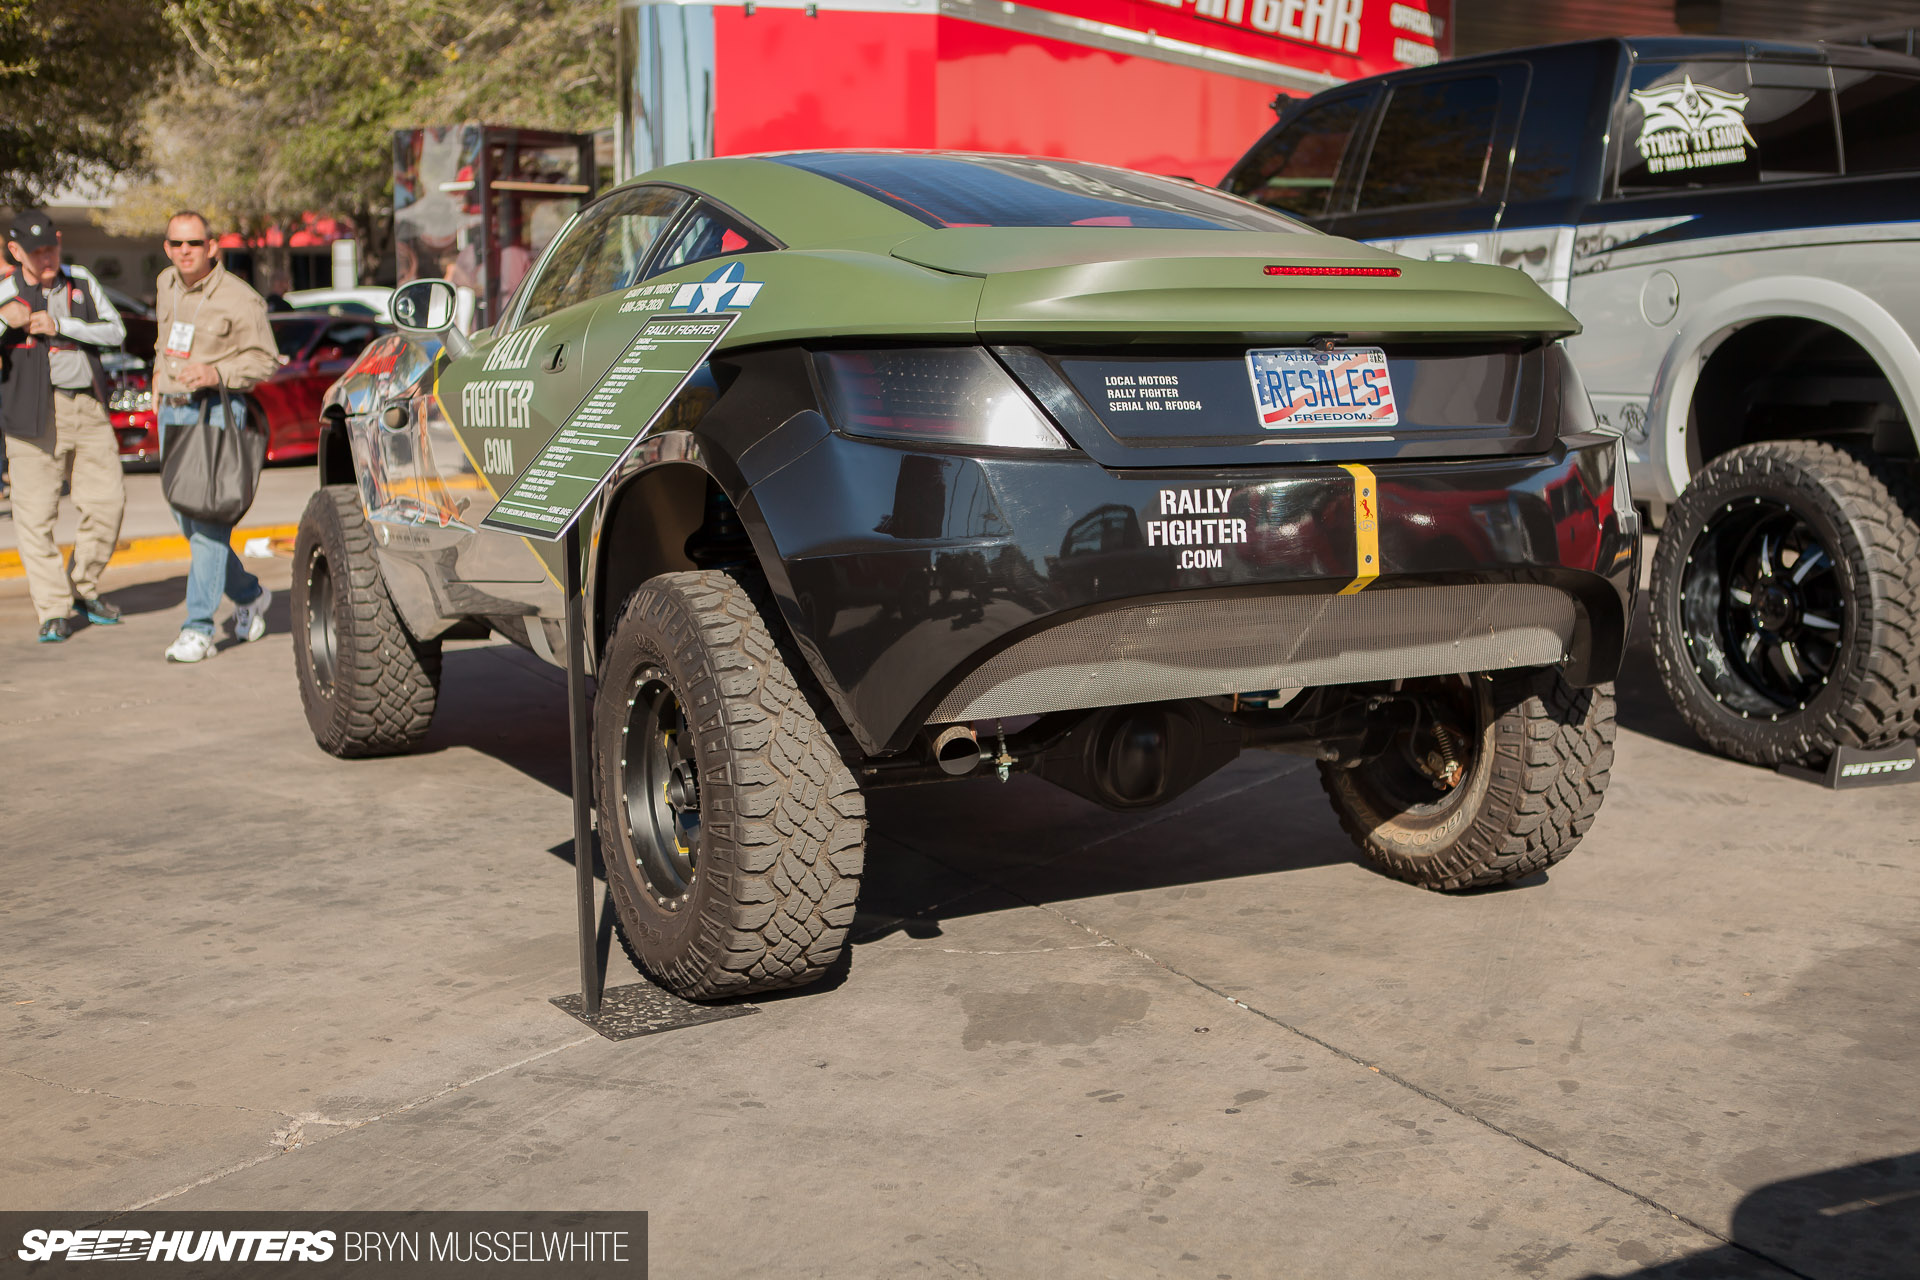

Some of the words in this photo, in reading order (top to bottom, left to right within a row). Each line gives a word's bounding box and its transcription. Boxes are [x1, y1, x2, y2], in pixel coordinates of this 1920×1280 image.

[1250, 0, 1363, 53] GEAR
[1640, 130, 1689, 159] STREET
[1690, 128, 1711, 151] TO
[1711, 122, 1745, 148] SAND
[643, 325, 676, 336] RALLY
[674, 324, 721, 335] FIGHTER
[482, 324, 550, 372] RALLY
[1285, 353, 1352, 362] ARIZONA
[1105, 376, 1136, 387] LOCAL
[1138, 375, 1179, 386] MOTORS
[1266, 369, 1381, 409] RFSALES
[1107, 388, 1137, 399] RALLY
[1140, 388, 1179, 398] FIGHTER
[461, 380, 535, 429] FIGHTER
[1109, 401, 1143, 412] SERIAL
[1145, 401, 1164, 411] NO.
[1165, 400, 1202, 411] RF0064
[1294, 412, 1367, 422] FREEDOM
[482, 438, 514, 476] .COM
[547, 506, 562, 515] HOME
[558, 507, 573, 516] BASE
[1159, 487, 1233, 516] RALLY
[1147, 518, 1248, 547] FIGHTER
[1176, 549, 1223, 570] .COM
[1841, 759, 1914, 777] NITTO
